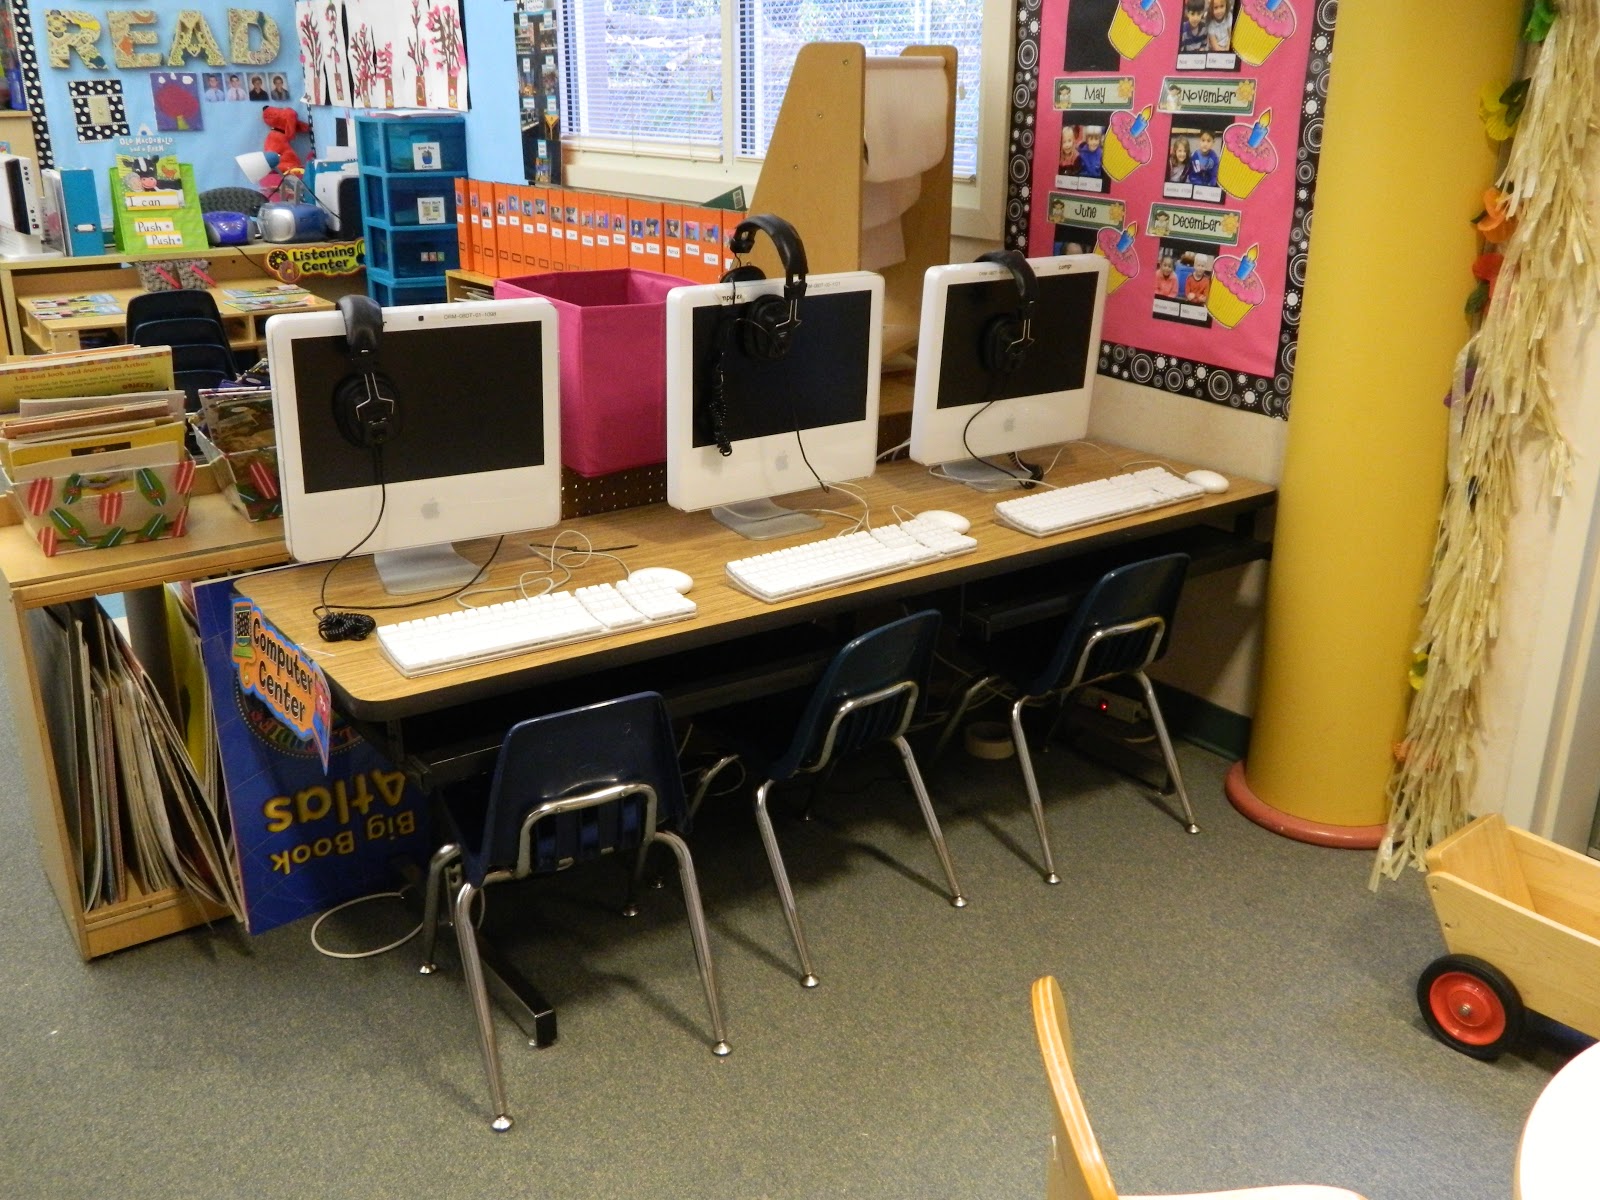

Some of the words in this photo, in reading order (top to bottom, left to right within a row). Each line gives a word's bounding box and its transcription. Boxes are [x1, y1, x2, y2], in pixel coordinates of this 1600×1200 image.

[44, 8, 281, 70] READ
[1083, 85, 1106, 104] May
[1181, 88, 1236, 104] November
[142, 198, 161, 207] can
[1074, 204, 1097, 219] June
[137, 222, 162, 232] Push
[1172, 214, 1221, 232] December
[151, 235, 176, 245] Push
[292, 246, 355, 262] Listening
[302, 258, 349, 272] Center
[253, 618, 313, 696] Computer
[258, 660, 306, 723] Center
[263, 768, 407, 833] Atlas
[367, 809, 416, 842] Big
[269, 829, 355, 875] Book
